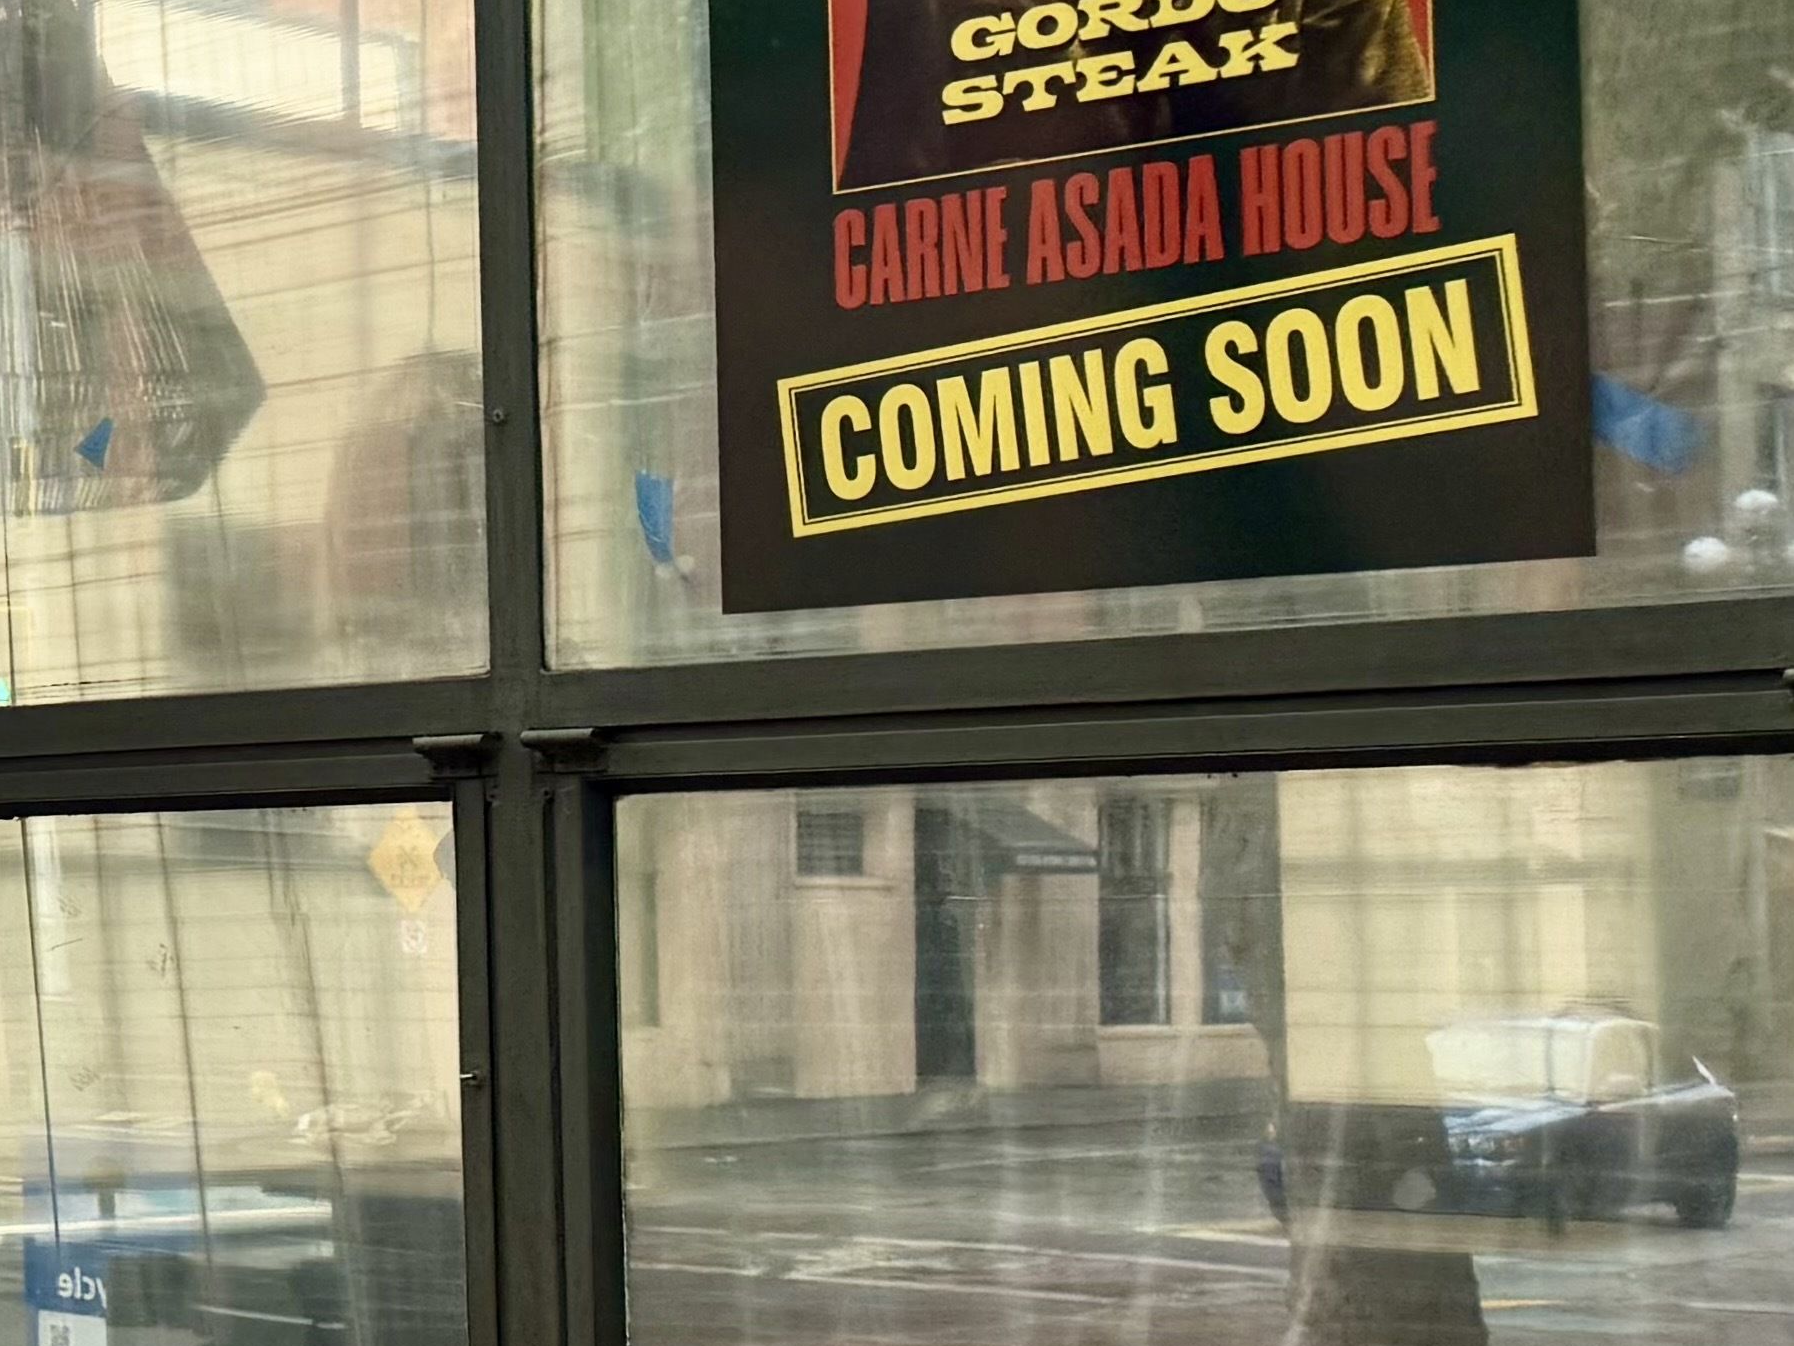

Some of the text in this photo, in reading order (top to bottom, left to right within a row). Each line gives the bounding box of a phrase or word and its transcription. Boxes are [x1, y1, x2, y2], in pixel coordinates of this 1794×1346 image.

[942, 22, 1299, 125] STEAK
[834, 121, 1440, 311] CARNE ASADA HOUSE
[821, 278, 1480, 501] COMING SOON
